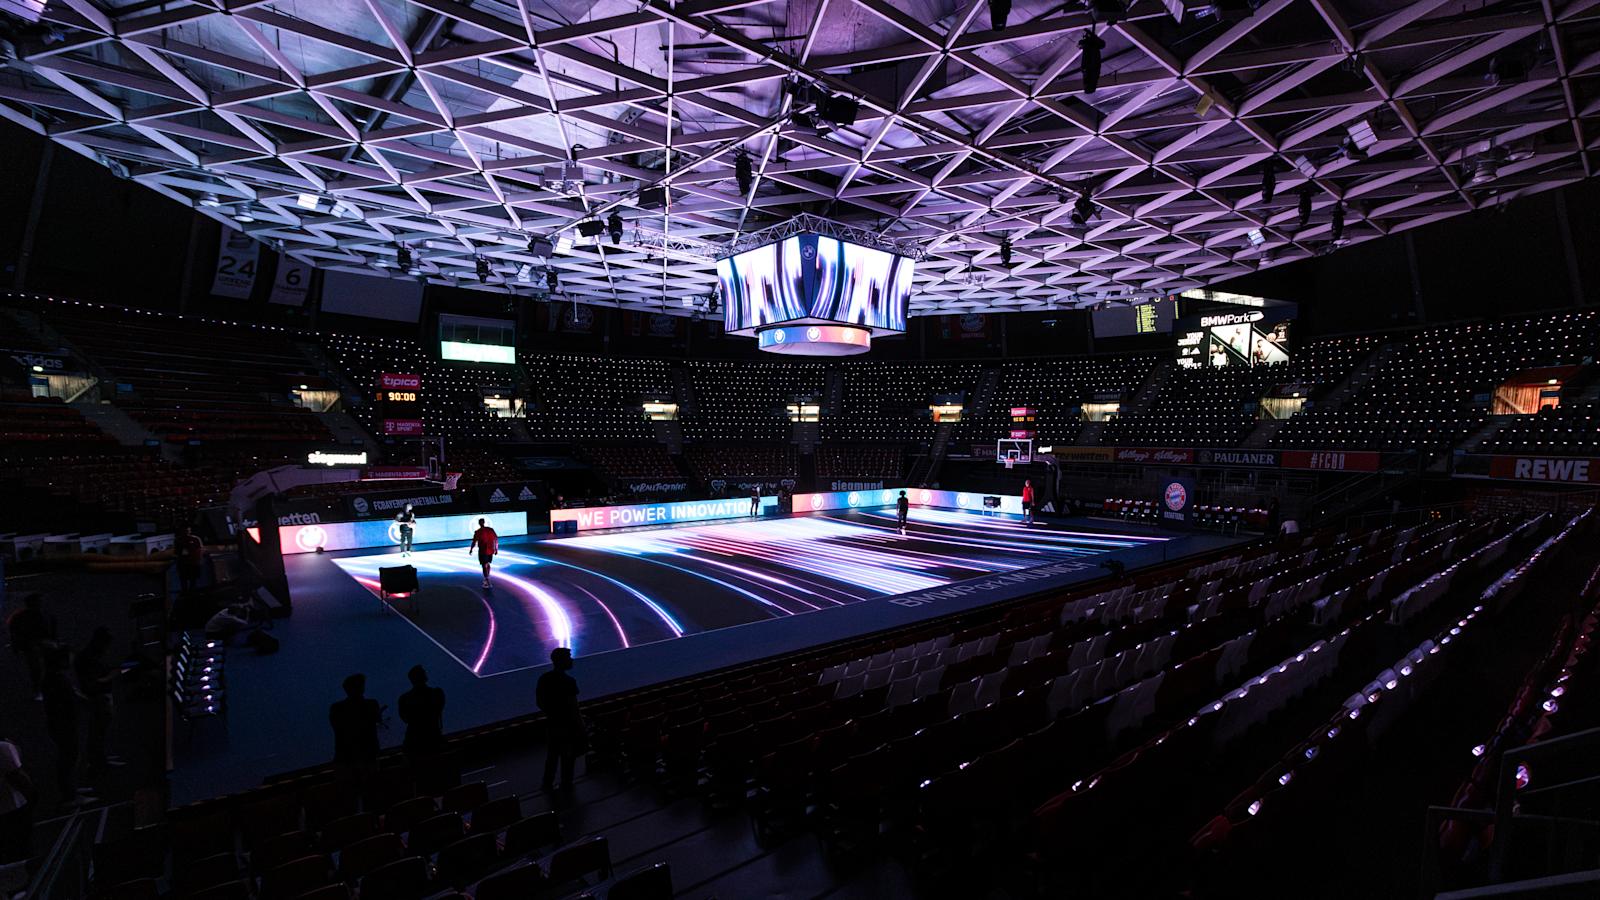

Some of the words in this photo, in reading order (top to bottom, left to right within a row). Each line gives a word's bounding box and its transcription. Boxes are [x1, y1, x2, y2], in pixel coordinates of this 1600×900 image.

[219, 256, 255, 278] 24
[286, 269, 300, 285] 6
[1201, 312, 1250, 327] BMWPark
[383, 376, 418, 387] tipico
[388, 391, 416, 402] 90:00
[1213, 452, 1275, 465] PAULANER
[1514, 458, 1591, 482] REWE
[578, 511, 604, 527] WE
[609, 506, 666, 524] POWER
